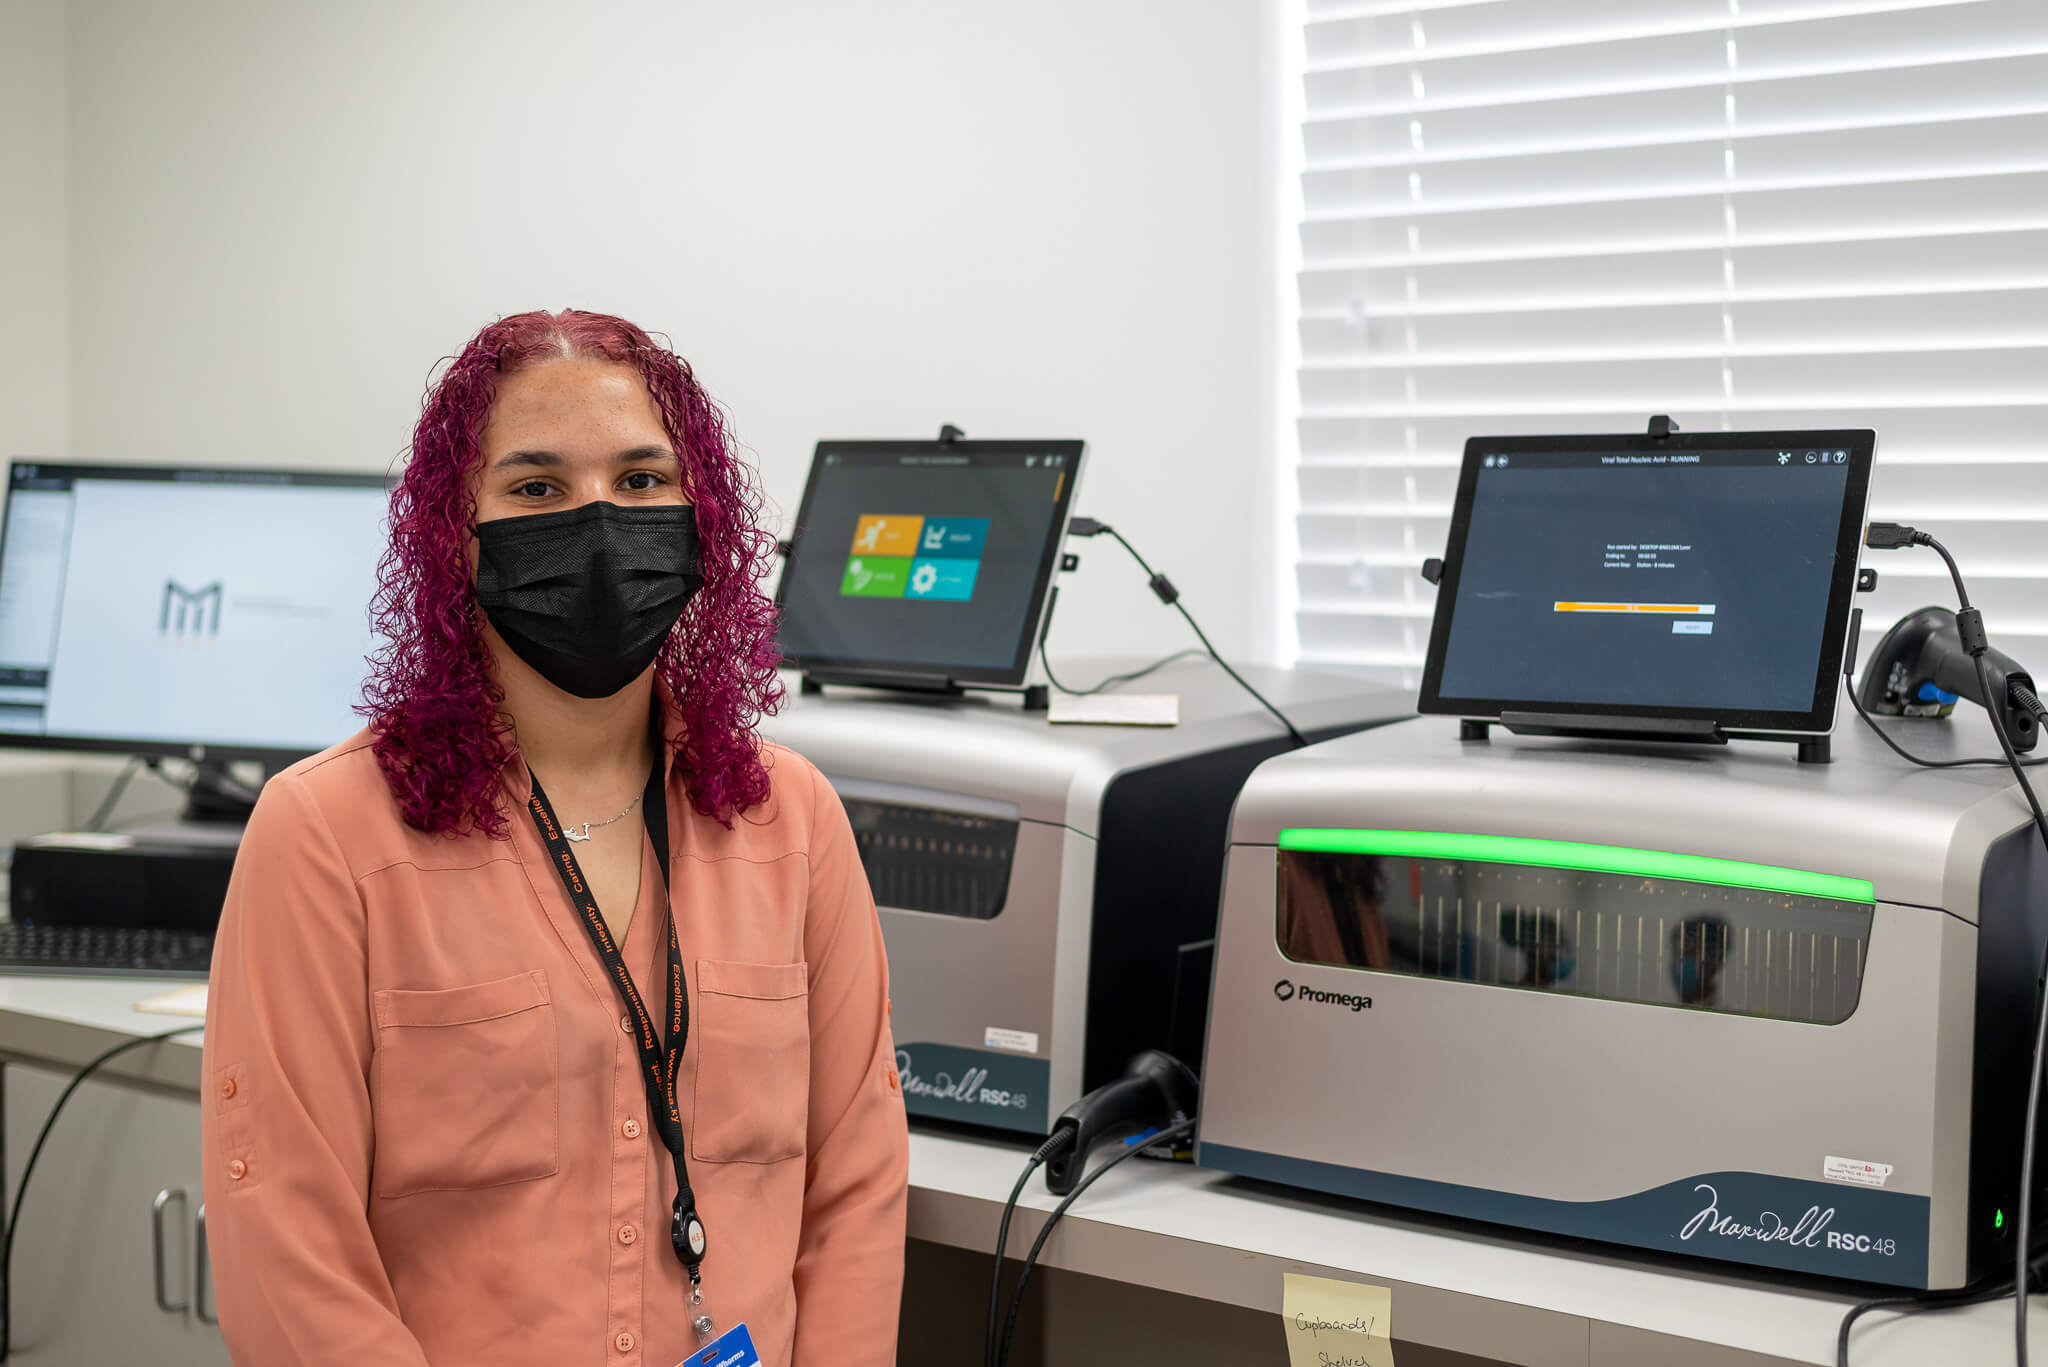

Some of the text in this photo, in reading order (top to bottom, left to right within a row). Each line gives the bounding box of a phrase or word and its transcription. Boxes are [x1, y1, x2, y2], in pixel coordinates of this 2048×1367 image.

[1670, 455, 1700, 463] RUNNING
[561, 850, 584, 893] Caring.
[672, 964, 684, 1036] Excellence.
[1299, 984, 1373, 1012] Promega
[1680, 1184, 1836, 1248] Maxwell
